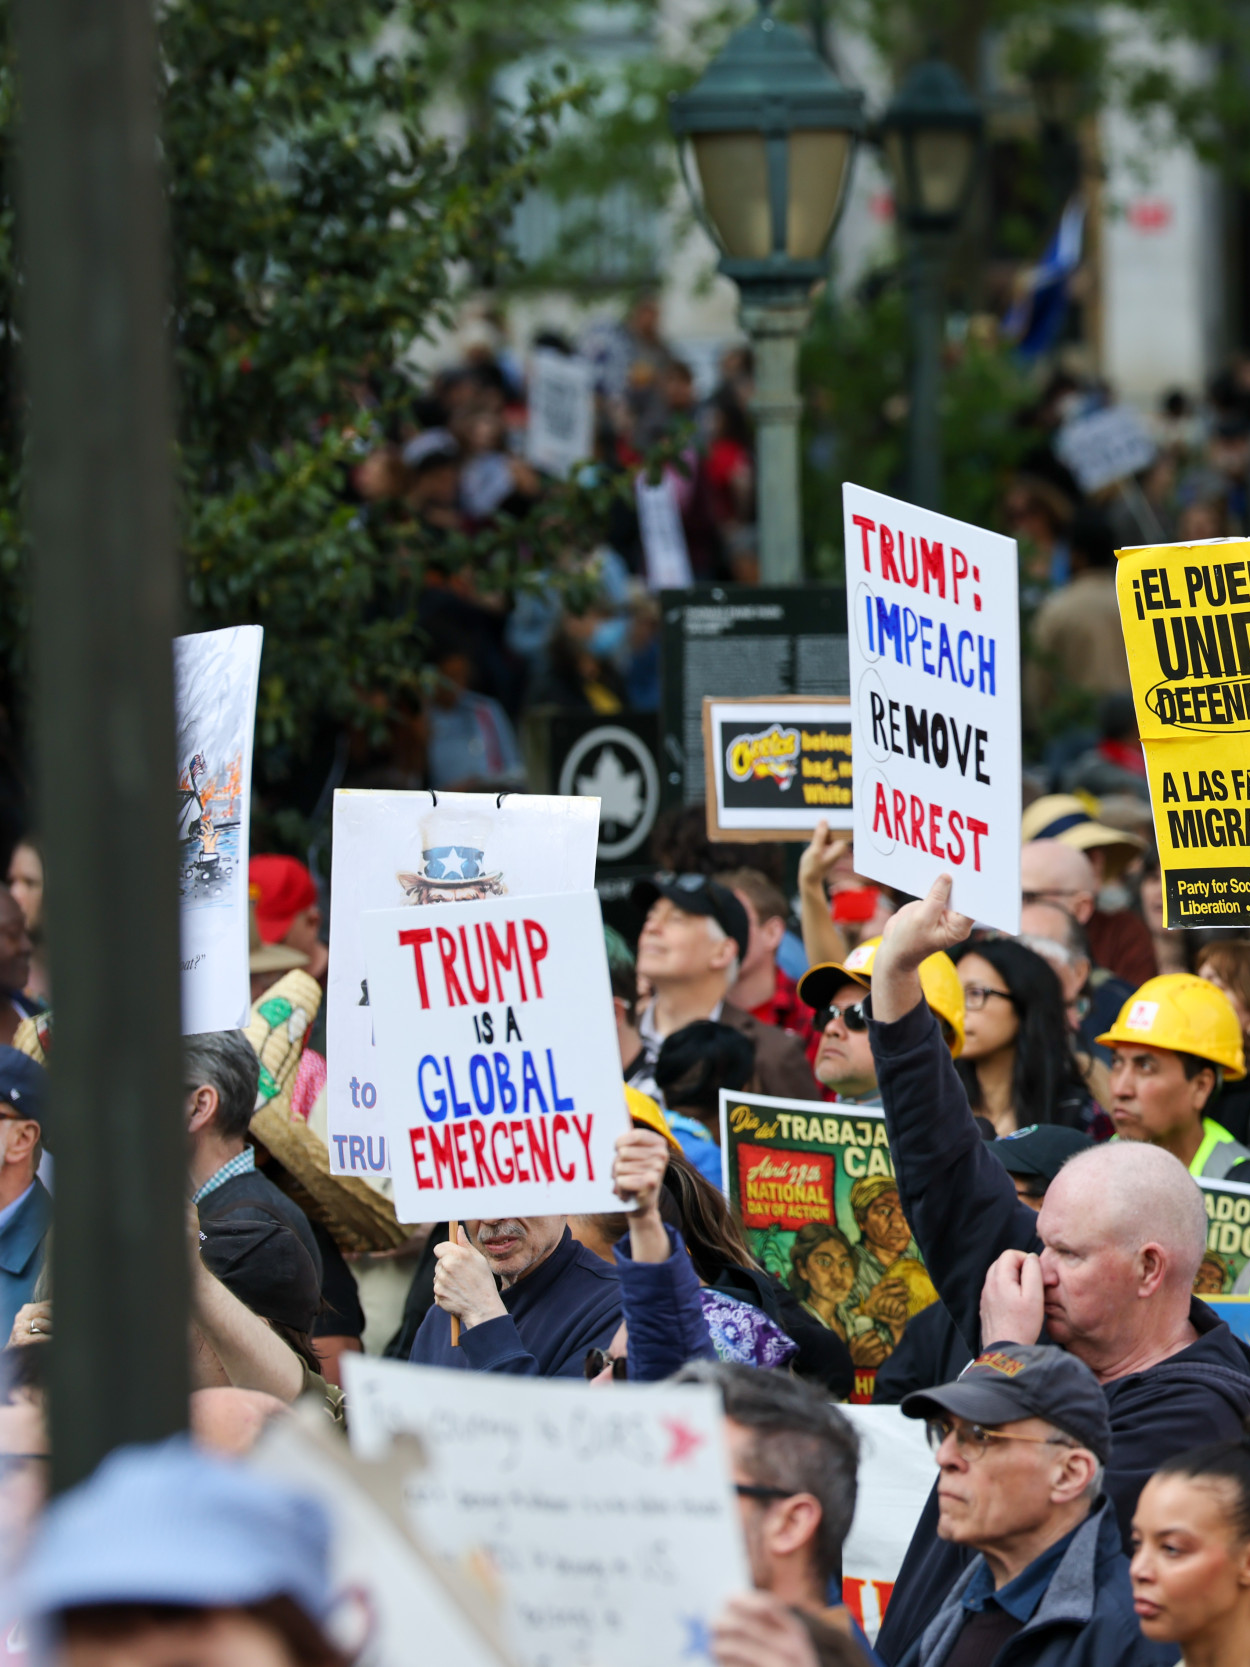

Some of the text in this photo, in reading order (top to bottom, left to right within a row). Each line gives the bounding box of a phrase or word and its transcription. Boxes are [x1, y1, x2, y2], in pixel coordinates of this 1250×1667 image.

[852, 513, 982, 612] TRUMP:
[1132, 567, 1181, 621] ¡EL
[865, 595, 997, 697] IMPEACH
[869, 690, 992, 786] REMOVE
[1163, 771, 1181, 804] A
[1183, 769, 1229, 803] LAS
[871, 781, 990, 874] ARREST
[1178, 880, 1210, 898] Party
[1212, 878, 1229, 895] for
[1179, 897, 1241, 916] Liberation
[397, 918, 550, 1010] TRUMP
[473, 1005, 523, 1045] IS A
[349, 1076, 377, 1109] to
[416, 1048, 576, 1123] GLOBAL
[332, 1133, 391, 1171] TRU
[408, 1113, 596, 1191] EMERGENCY
[746, 1181, 829, 1205] NATIONAL
[747, 1202, 769, 1216] DAY
[787, 1205, 830, 1221] ACTION
